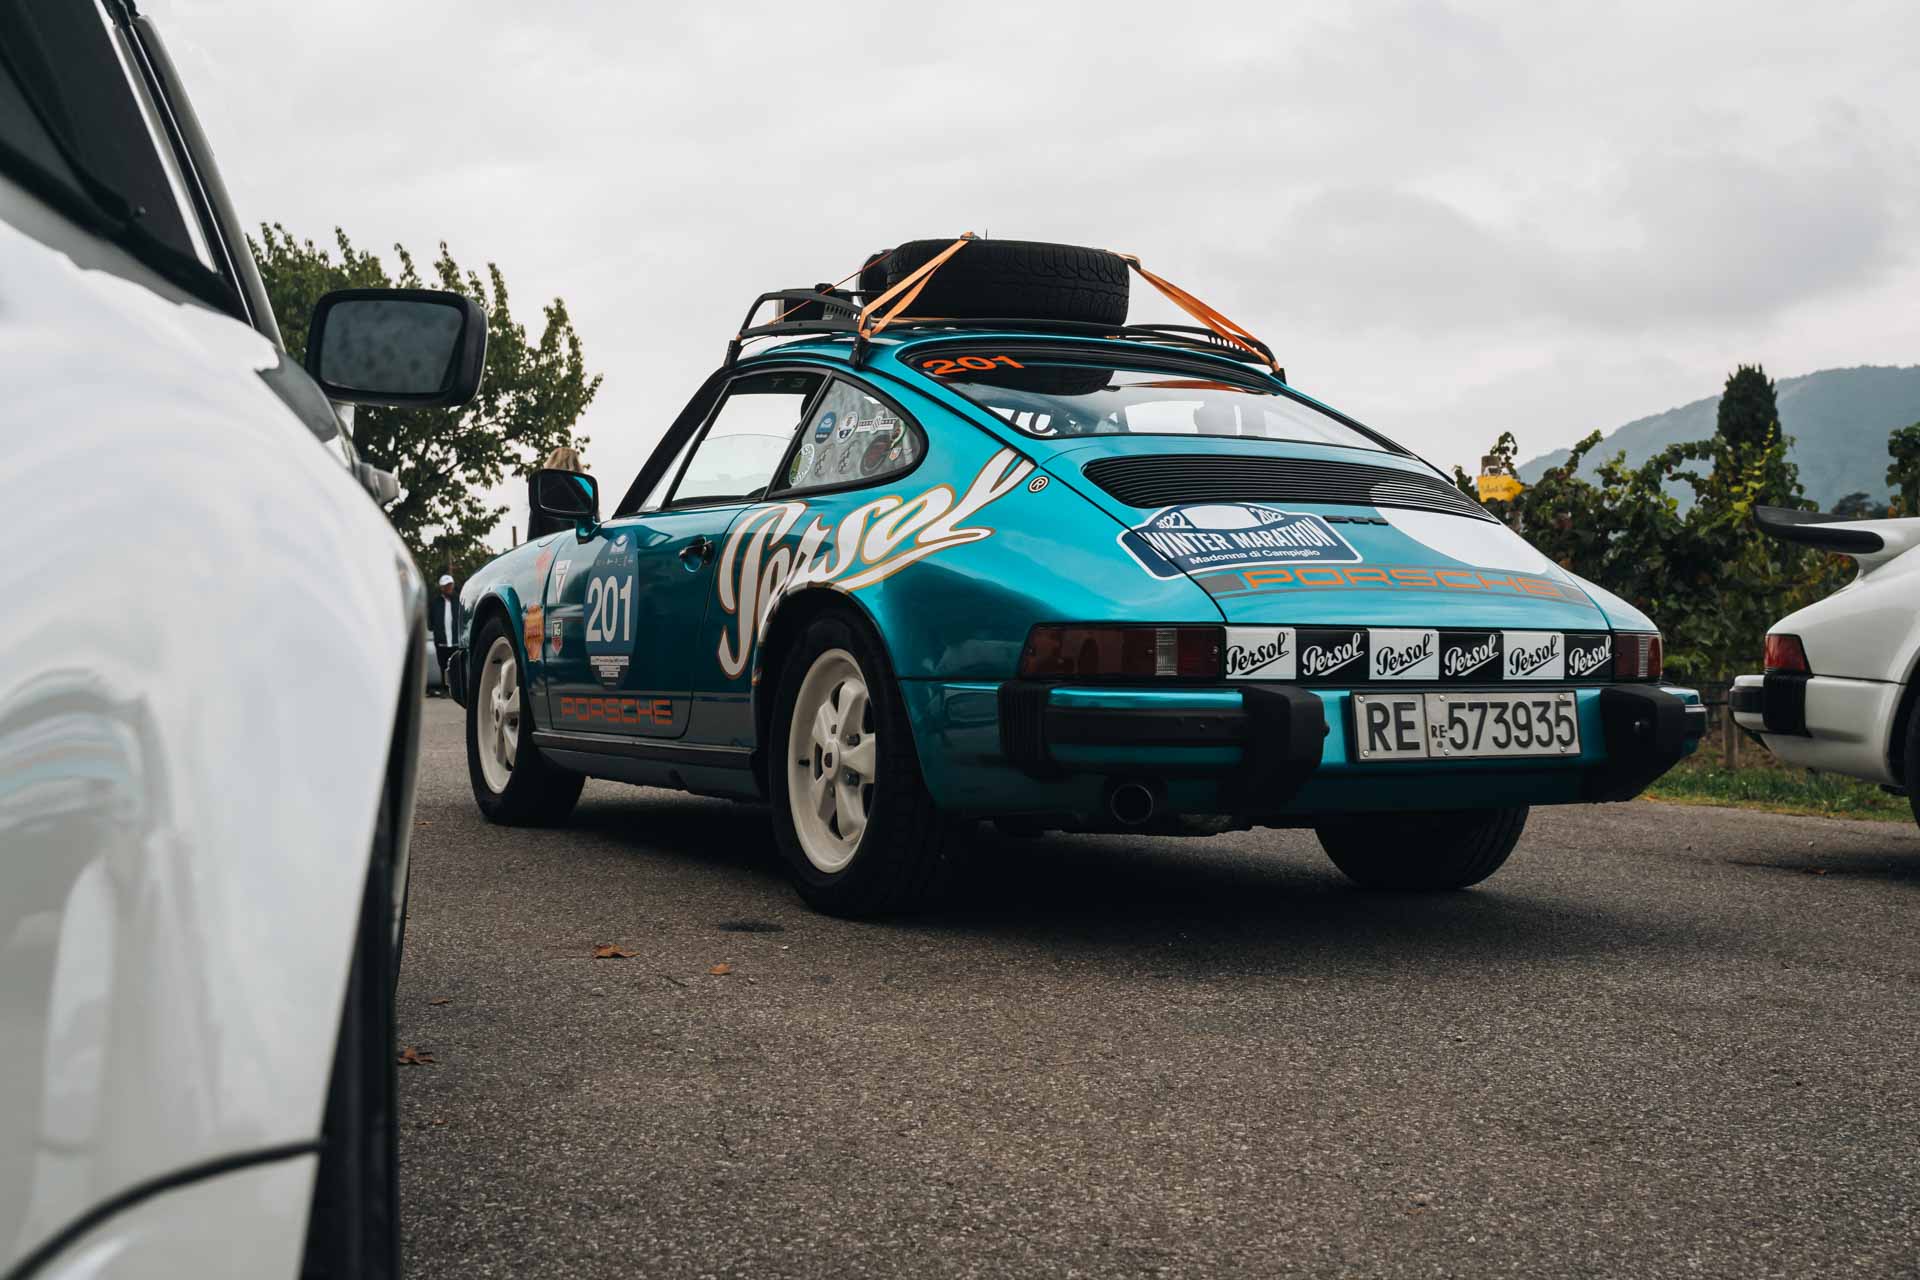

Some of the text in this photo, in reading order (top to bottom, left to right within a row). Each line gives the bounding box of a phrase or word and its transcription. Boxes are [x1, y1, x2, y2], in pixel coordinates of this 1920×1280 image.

[922, 353, 1025, 377] 201
[1156, 511, 1194, 529] 2022
[1137, 517, 1338, 561] WINTER MARATHON
[1189, 548, 1321, 565] Madonna di Campiglio
[1241, 567, 1560, 597] PORSCHE
[585, 575, 633, 642] 201
[1226, 631, 1612, 676] Persol Persol Persol Persol Persol Persol
[560, 697, 673, 725] PORSCHE
[1366, 700, 1576, 751] RE 573935
